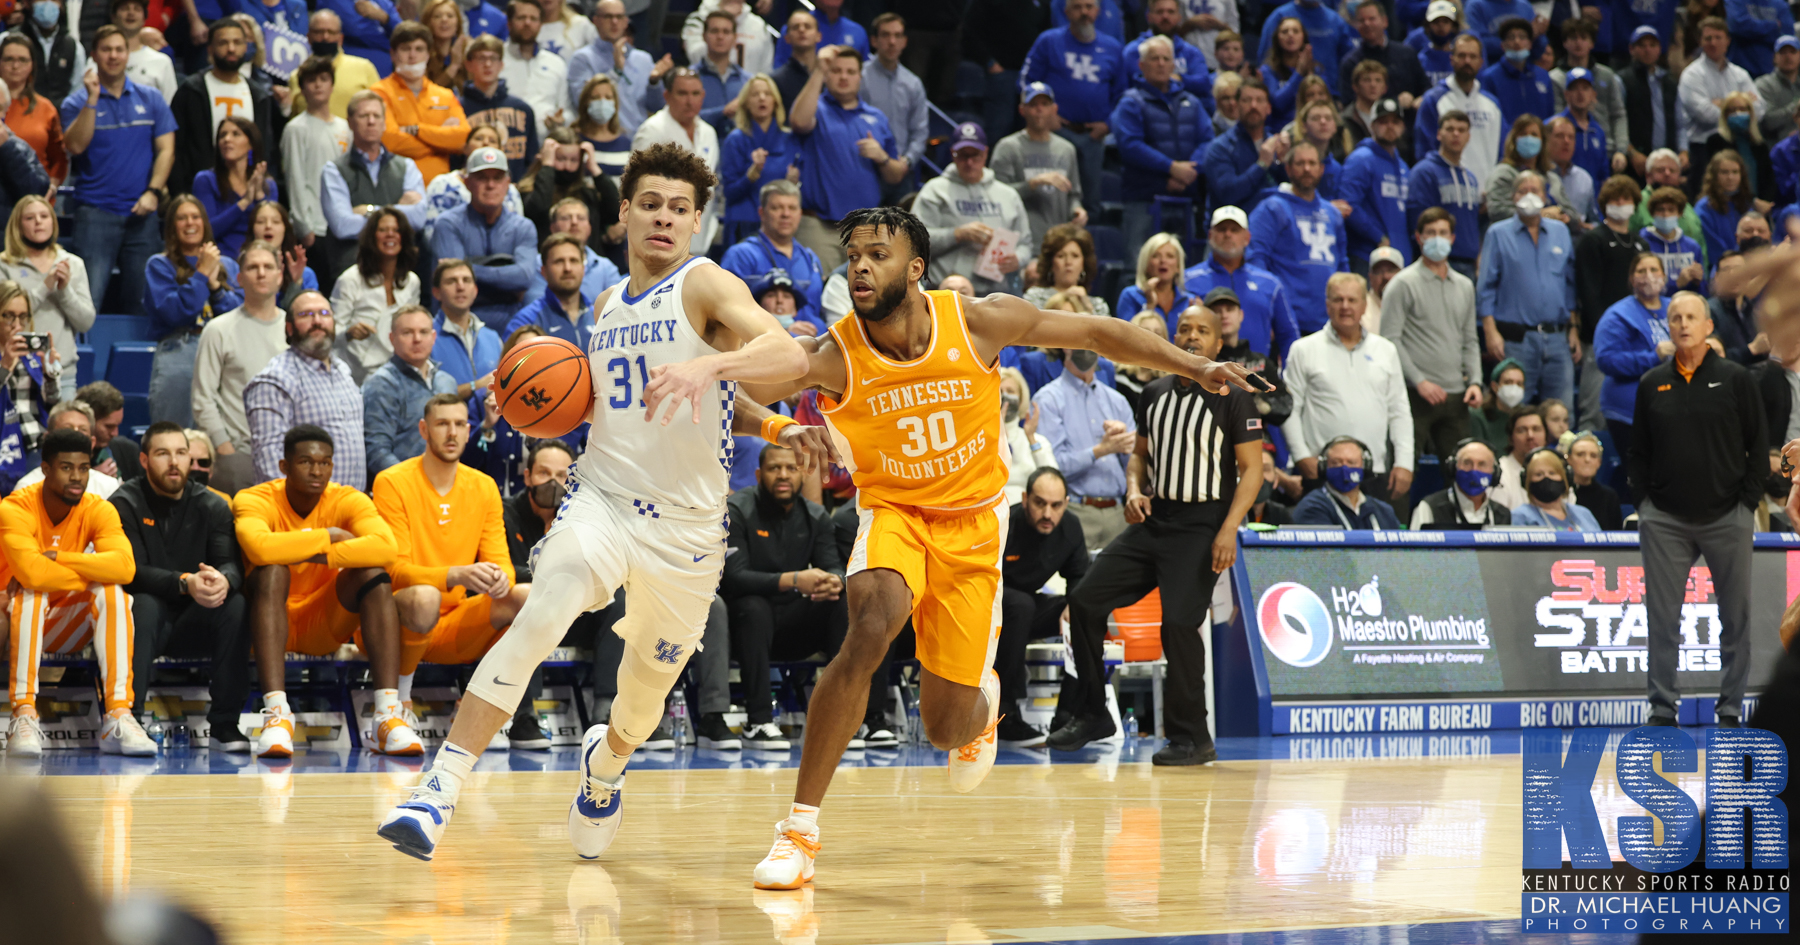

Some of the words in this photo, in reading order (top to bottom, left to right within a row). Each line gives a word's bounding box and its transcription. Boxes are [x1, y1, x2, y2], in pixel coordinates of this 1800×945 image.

[1296, 220, 1336, 263] UK
[590, 319, 677, 354] KENTUCKY
[519, 386, 553, 412] UK
[866, 379, 973, 416] TENNESSEE
[897, 410, 957, 457] 30
[879, 429, 986, 480] VOLUNTEERS
[439, 504, 450, 515] T
[1296, 531, 1316, 542] FARM
[1337, 615, 1408, 641] Maestro
[1408, 614, 1490, 646] Plumbing
[653, 637, 684, 664] UK
[1353, 653, 1361, 663] A
[1361, 653, 1392, 665] Fayette
[1392, 652, 1424, 665] Heating
[1425, 653, 1432, 663] &
[1433, 652, 1445, 663] Air
[1446, 652, 1484, 665] Company
[1560, 650, 1722, 673] BATTIES
[1289, 707, 1376, 733] KENTUCKY
[1380, 705, 1423, 731] FARM
[1429, 703, 1492, 730] BUREAU
[1520, 702, 1547, 727] BIG
[1551, 702, 1574, 726] ON
[1578, 699, 1682, 725] COMMITM
